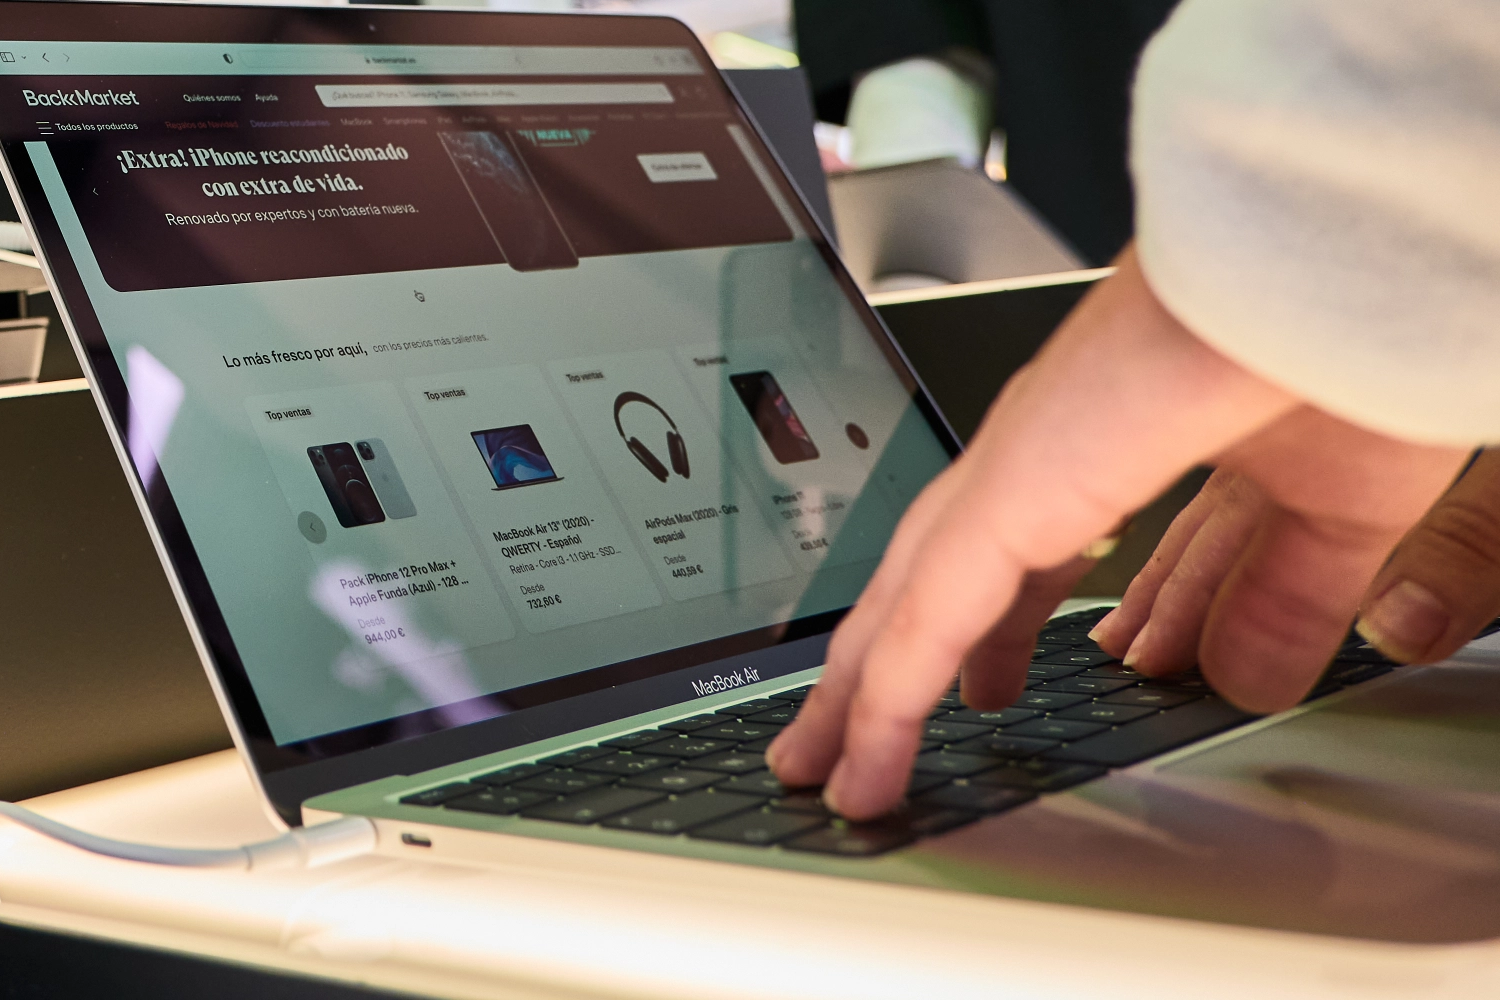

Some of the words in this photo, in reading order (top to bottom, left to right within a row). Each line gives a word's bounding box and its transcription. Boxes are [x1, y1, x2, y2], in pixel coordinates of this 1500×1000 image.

[216, 94, 241, 102] somos
[255, 94, 279, 104] Ayuda
[55, 122, 80, 132] Todos
[82, 122, 95, 131] los
[96, 122, 139, 133] productos
[117, 149, 189, 174] ¡Extra!
[188, 147, 258, 168] iPhone
[259, 143, 409, 165] reacondicionado
[202, 179, 239, 197] con
[240, 177, 292, 196] extra
[293, 174, 316, 194] de
[314, 173, 364, 192] vida.
[165, 212, 230, 226] Renovado
[232, 210, 252, 226] por
[254, 208, 307, 224] expertos
[308, 208, 316, 221] y
[318, 207, 340, 218] con
[341, 203, 381, 218] batería
[382, 204, 420, 216] nueva.
[372, 344, 390, 354] con
[390, 342, 402, 352] los
[403, 338, 434, 351] precios
[434, 336, 452, 346] más
[452, 332, 490, 345] calientes.
[223, 355, 241, 368] Lo
[243, 352, 271, 366] más
[272, 350, 313, 364] fresco
[314, 348, 334, 362] por
[337, 342, 368, 357] aquí,
[566, 373, 580, 384] Top
[424, 390, 440, 402] Top
[440, 388, 466, 399] ventas
[265, 410, 282, 422] Top
[283, 407, 312, 418] ventas
[492, 526, 536, 542] MacBook
[535, 524, 548, 535] Air
[562, 516, 590, 531] (2020)
[644, 515, 677, 530] AirPods
[677, 512, 694, 524] Max
[652, 530, 686, 545] espacial
[501, 541, 542, 559] QWERTY
[547, 534, 582, 550] Español
[509, 562, 536, 575] Retina
[538, 558, 558, 570] Core
[558, 555, 566, 566] i3
[578, 550, 596, 561] GHz
[664, 553, 687, 566] Desde
[340, 576, 366, 590] Pack
[365, 570, 399, 585] iPhone
[399, 566, 412, 578] 12
[410, 564, 428, 576] Pro
[428, 561, 450, 573] Max
[348, 592, 378, 608] Apple
[377, 586, 409, 601] Funda
[408, 580, 437, 596] (Azul)
[442, 576, 460, 588] 128
[520, 583, 546, 596] Desde
[526, 596, 554, 610] 732,60
[358, 615, 386, 629] Desde
[364, 629, 398, 645] 944,00
[691, 670, 746, 697] MacBook
[743, 666, 760, 684] Air
